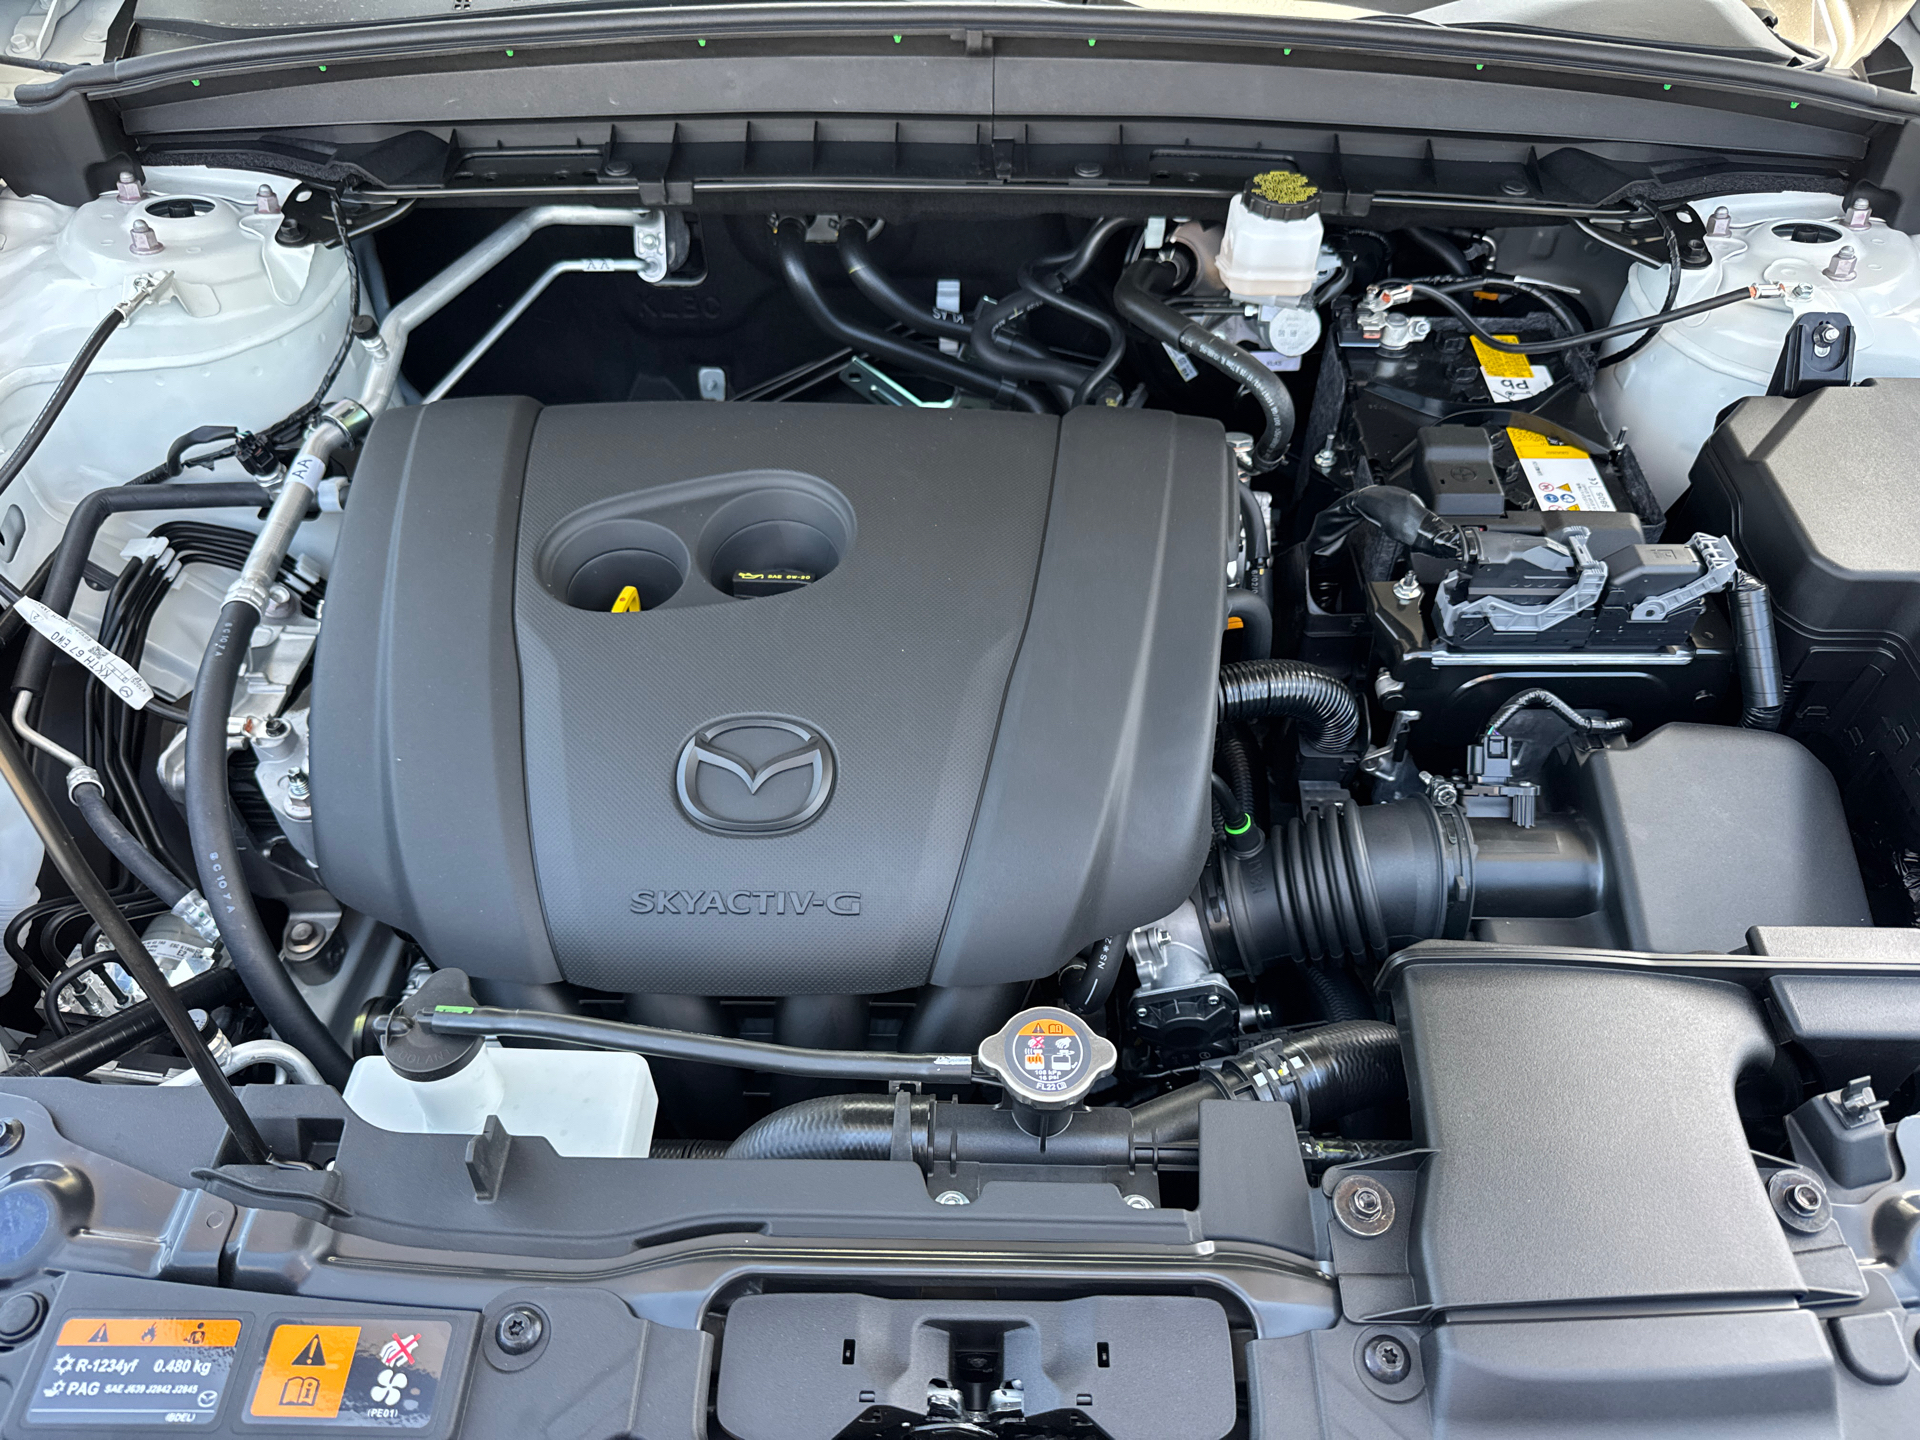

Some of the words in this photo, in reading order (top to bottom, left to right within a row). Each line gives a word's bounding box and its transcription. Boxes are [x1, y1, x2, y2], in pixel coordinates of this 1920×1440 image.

[1500, 380, 1530, 390] Pb
[292, 459, 312, 480] AA
[70, 646, 85, 658] 67
[84, 656, 112, 680] KKTH
[630, 889, 862, 916] SKYACTIV-G
[392, 1046, 451, 1064] COOLANT
[1036, 1082, 1056, 1090] FL22
[75, 1358, 139, 1376] R-1234yf
[153, 1359, 191, 1373] 0.480
[192, 1360, 212, 1376] kg
[66, 1382, 100, 1396] PAG
[104, 1384, 123, 1394] SAE
[367, 1408, 399, 1418] (PE01)
